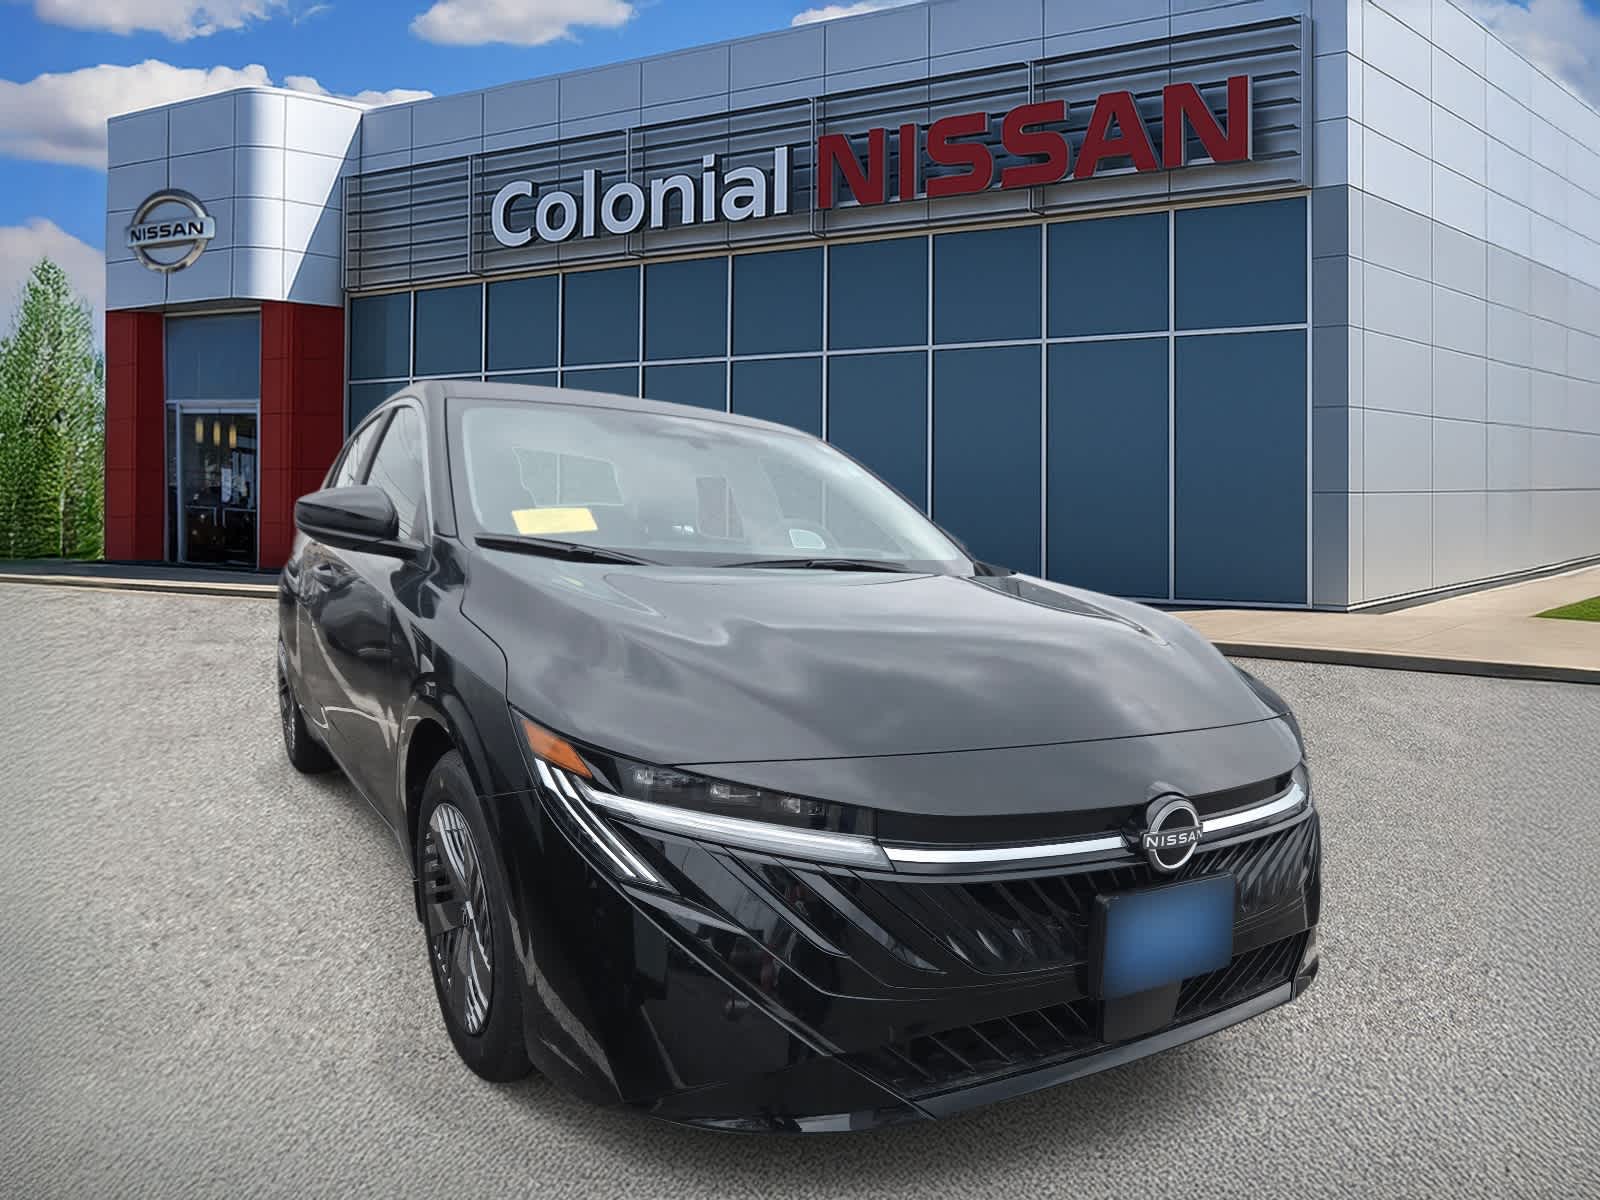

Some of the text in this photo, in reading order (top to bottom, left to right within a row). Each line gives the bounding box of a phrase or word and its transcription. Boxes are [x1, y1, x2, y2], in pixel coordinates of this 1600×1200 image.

[491, 75, 1253, 248] Colonial NISSAN
[130, 221, 204, 242] NISSAN
[1145, 829, 1203, 848] NISSAN
